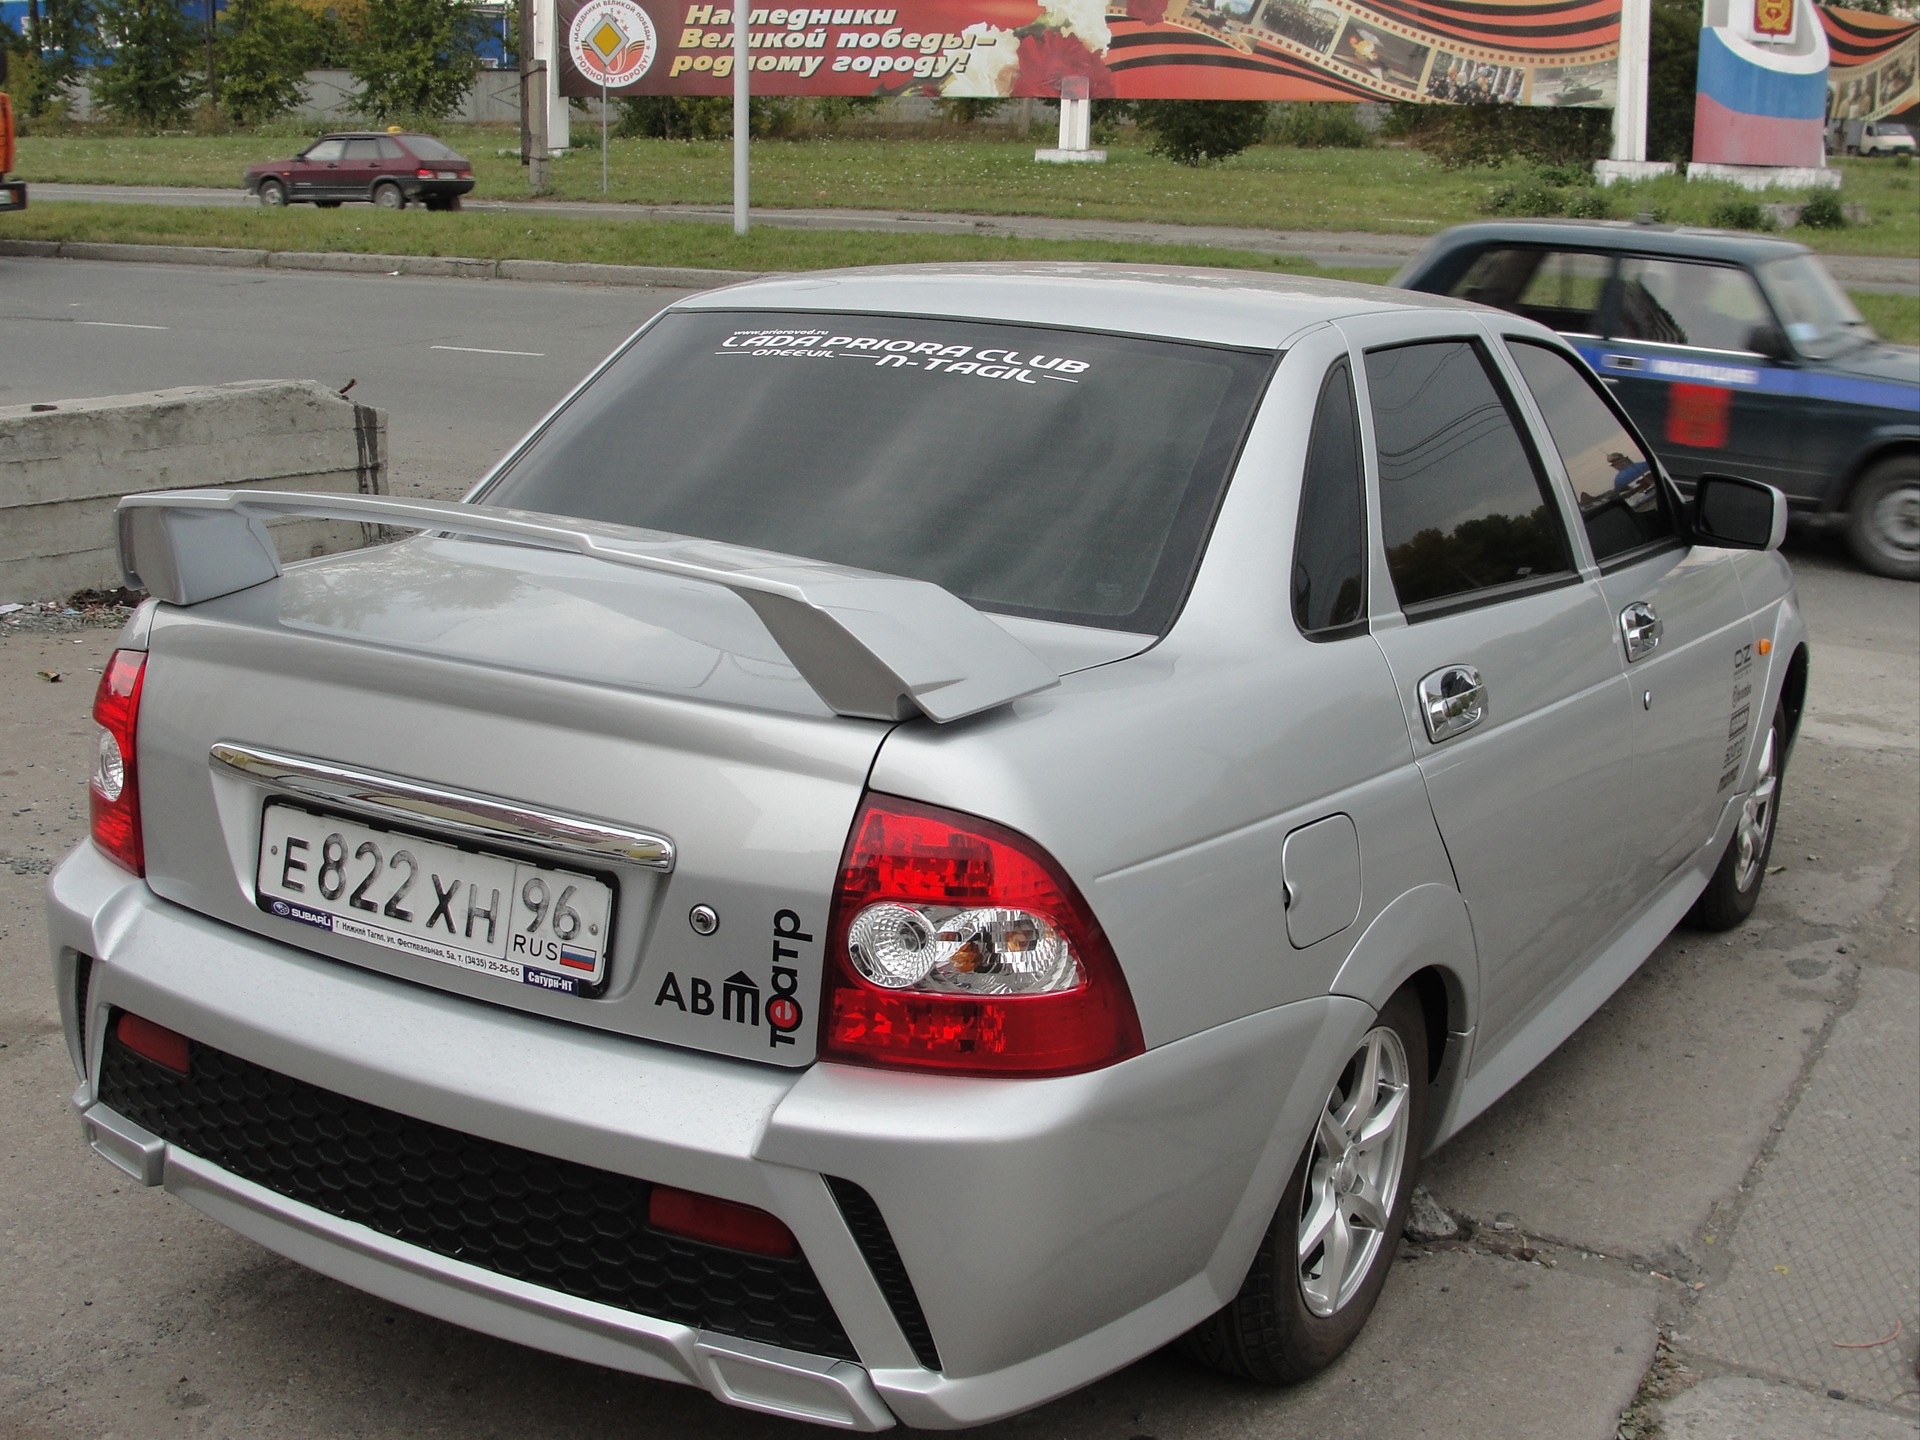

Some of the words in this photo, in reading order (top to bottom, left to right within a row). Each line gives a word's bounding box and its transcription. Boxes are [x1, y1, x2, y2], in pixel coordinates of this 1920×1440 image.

[573, 2, 602, 42] НАСЛЕДНИКИ
[602, 0, 636, 13] ВЕЛИКОЙ
[635, 12, 652, 41] ПОБЕДЫ
[684, 4, 897, 31] Наледники
[618, 54, 651, 84] ГОРОДУ!
[831, 52, 971, 78] городу!
[722, 335, 823, 348] LADA
[820, 336, 974, 359] PRIORA
[975, 349, 1091, 374] CLUB
[281, 832, 501, 944] Е822ХН
[521, 877, 582, 941] 96
[291, 907, 331, 927] SUBARU
[513, 933, 558, 961] RUS
[465, 955, 487, 969] (3435)
[488, 961, 520, 976] 25-25-65
[528, 971, 574, 992] Сатурн-НТ
